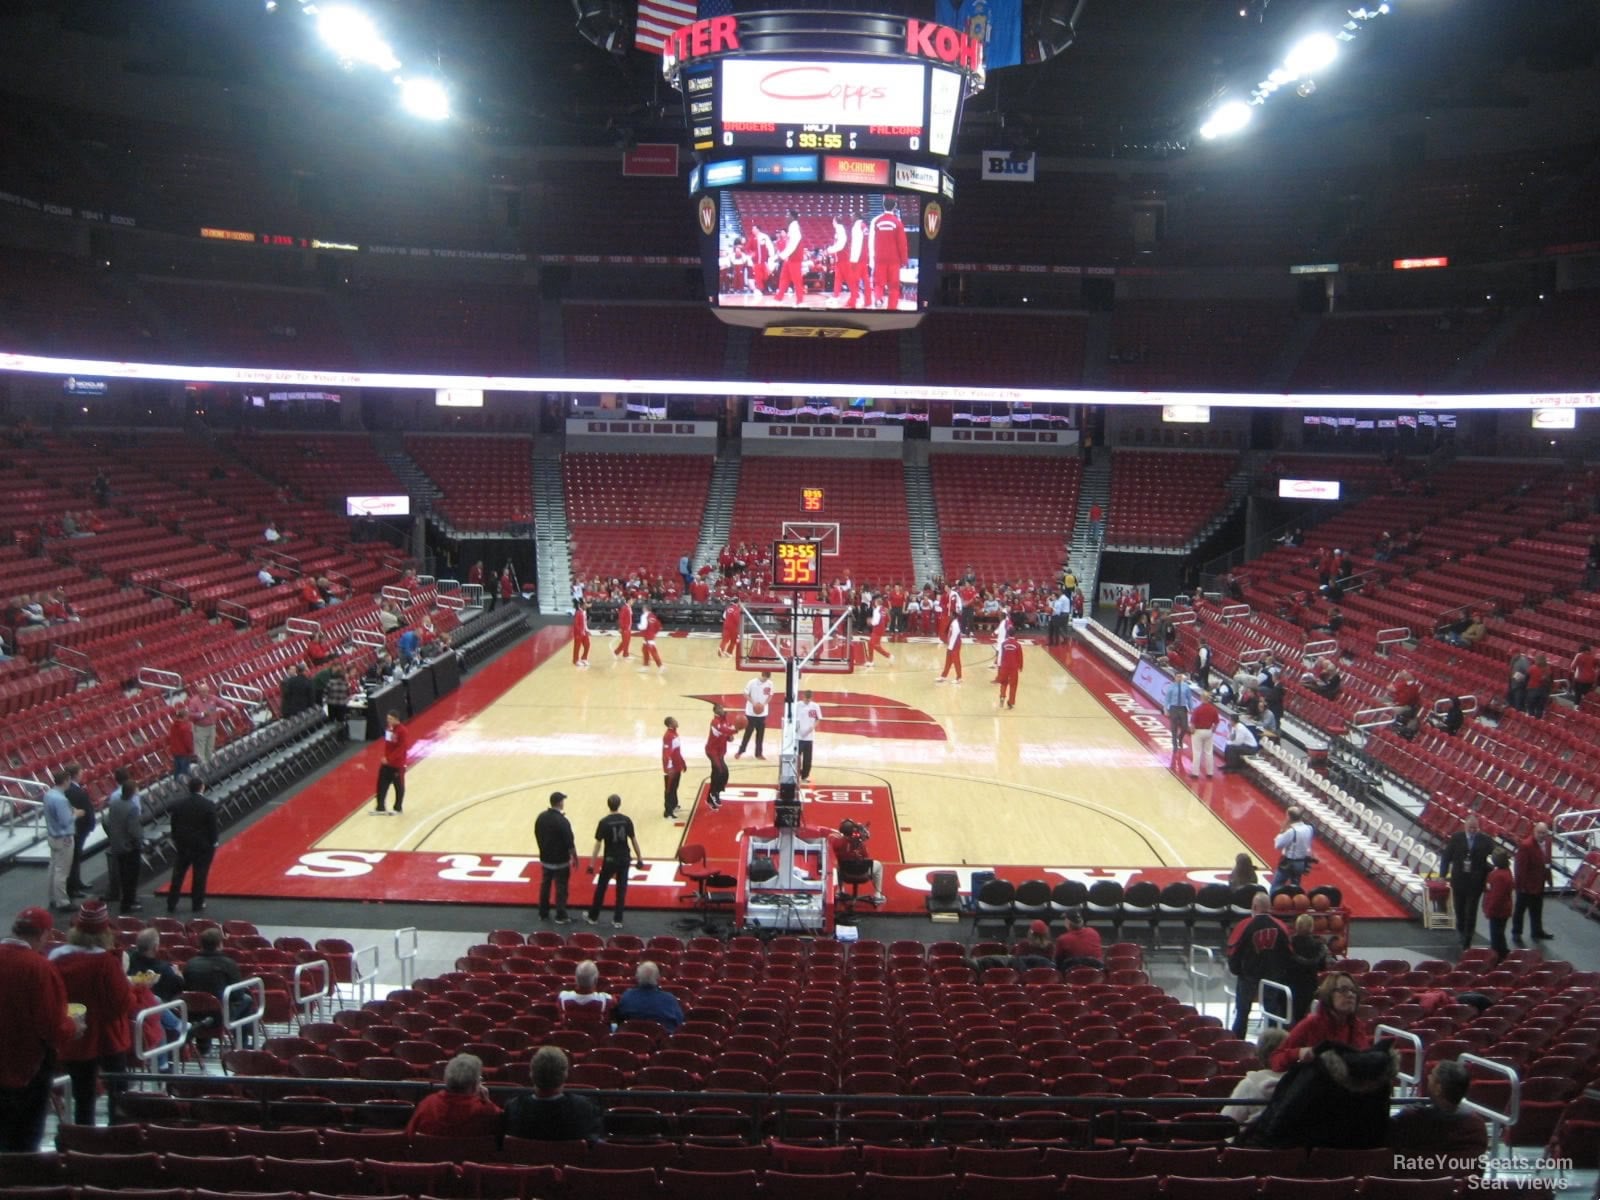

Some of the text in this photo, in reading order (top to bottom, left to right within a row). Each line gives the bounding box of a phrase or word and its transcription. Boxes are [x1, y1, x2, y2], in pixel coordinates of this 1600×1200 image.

[759, 66, 887, 110] Copps
[723, 122, 775, 132] BADGERS
[869, 125, 921, 135] FALCONS
[723, 131, 733, 146] 0
[910, 136, 919, 150] 0
[838, 160, 876, 173] HO-CHUNK
[702, 207, 713, 227] W
[927, 212, 938, 233] W
[805, 498, 820, 510] 35
[779, 544, 816, 558] 33:55
[783, 558, 811, 583] 35
[1252, 927, 1279, 953] W
